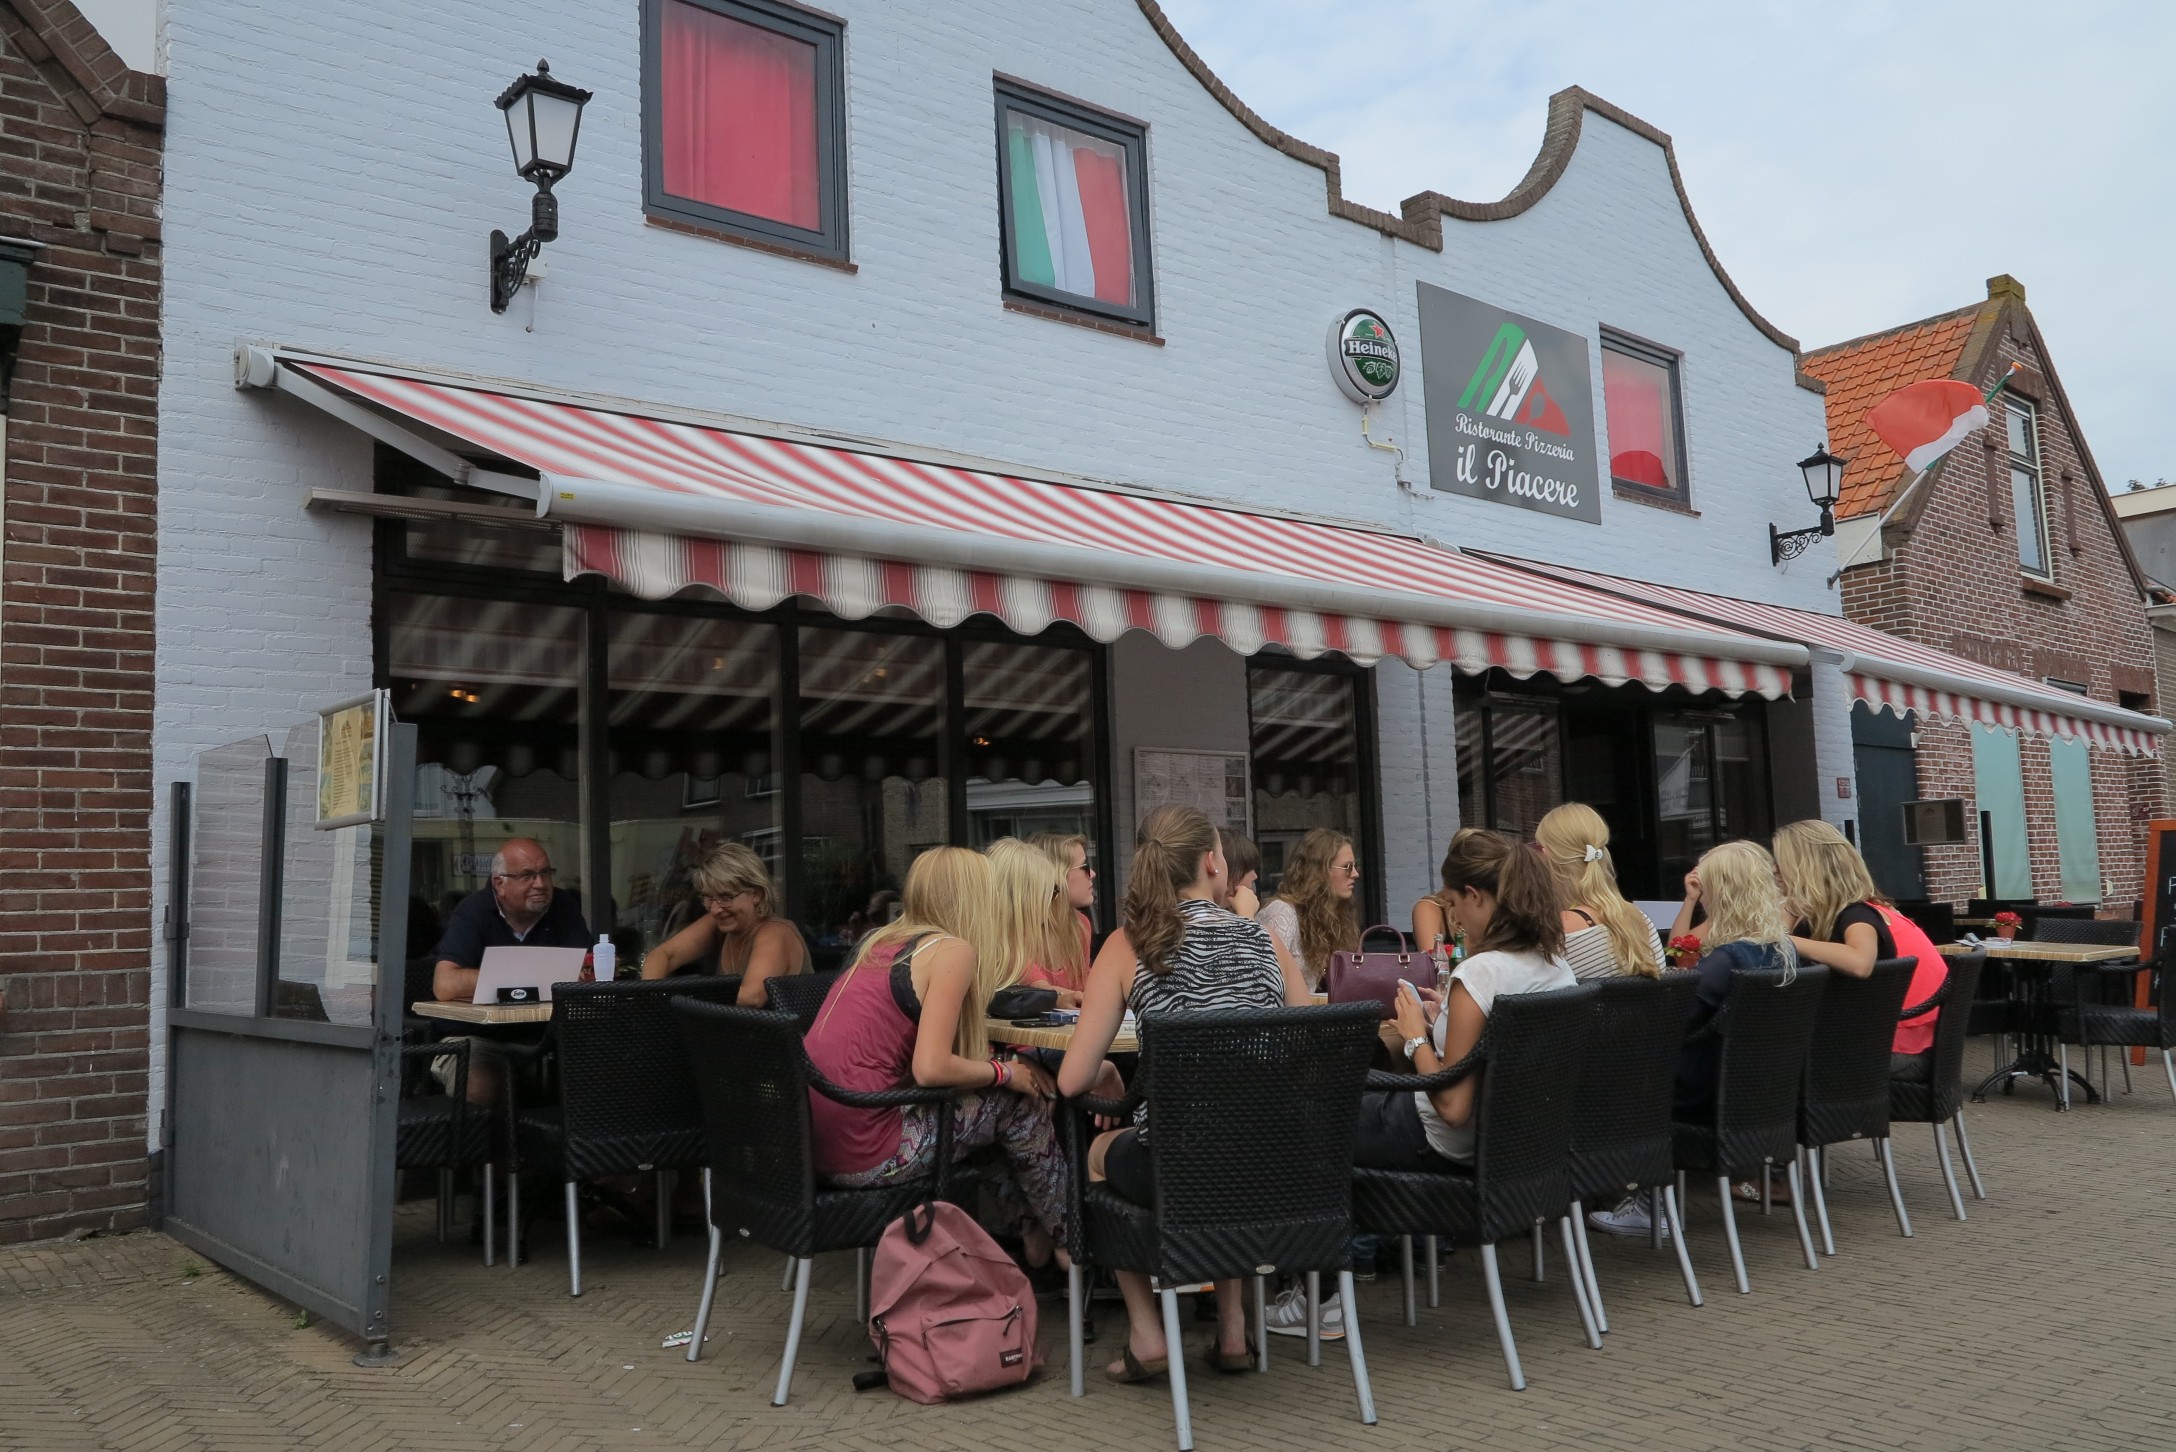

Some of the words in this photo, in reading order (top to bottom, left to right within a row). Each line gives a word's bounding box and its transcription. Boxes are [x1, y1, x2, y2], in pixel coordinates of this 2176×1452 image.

[1455, 413, 1522, 448] Ristorante
[1525, 431, 1575, 461] Pizzeria
[1456, 444, 1478, 484] il
[1485, 449, 1580, 508] Piacere
